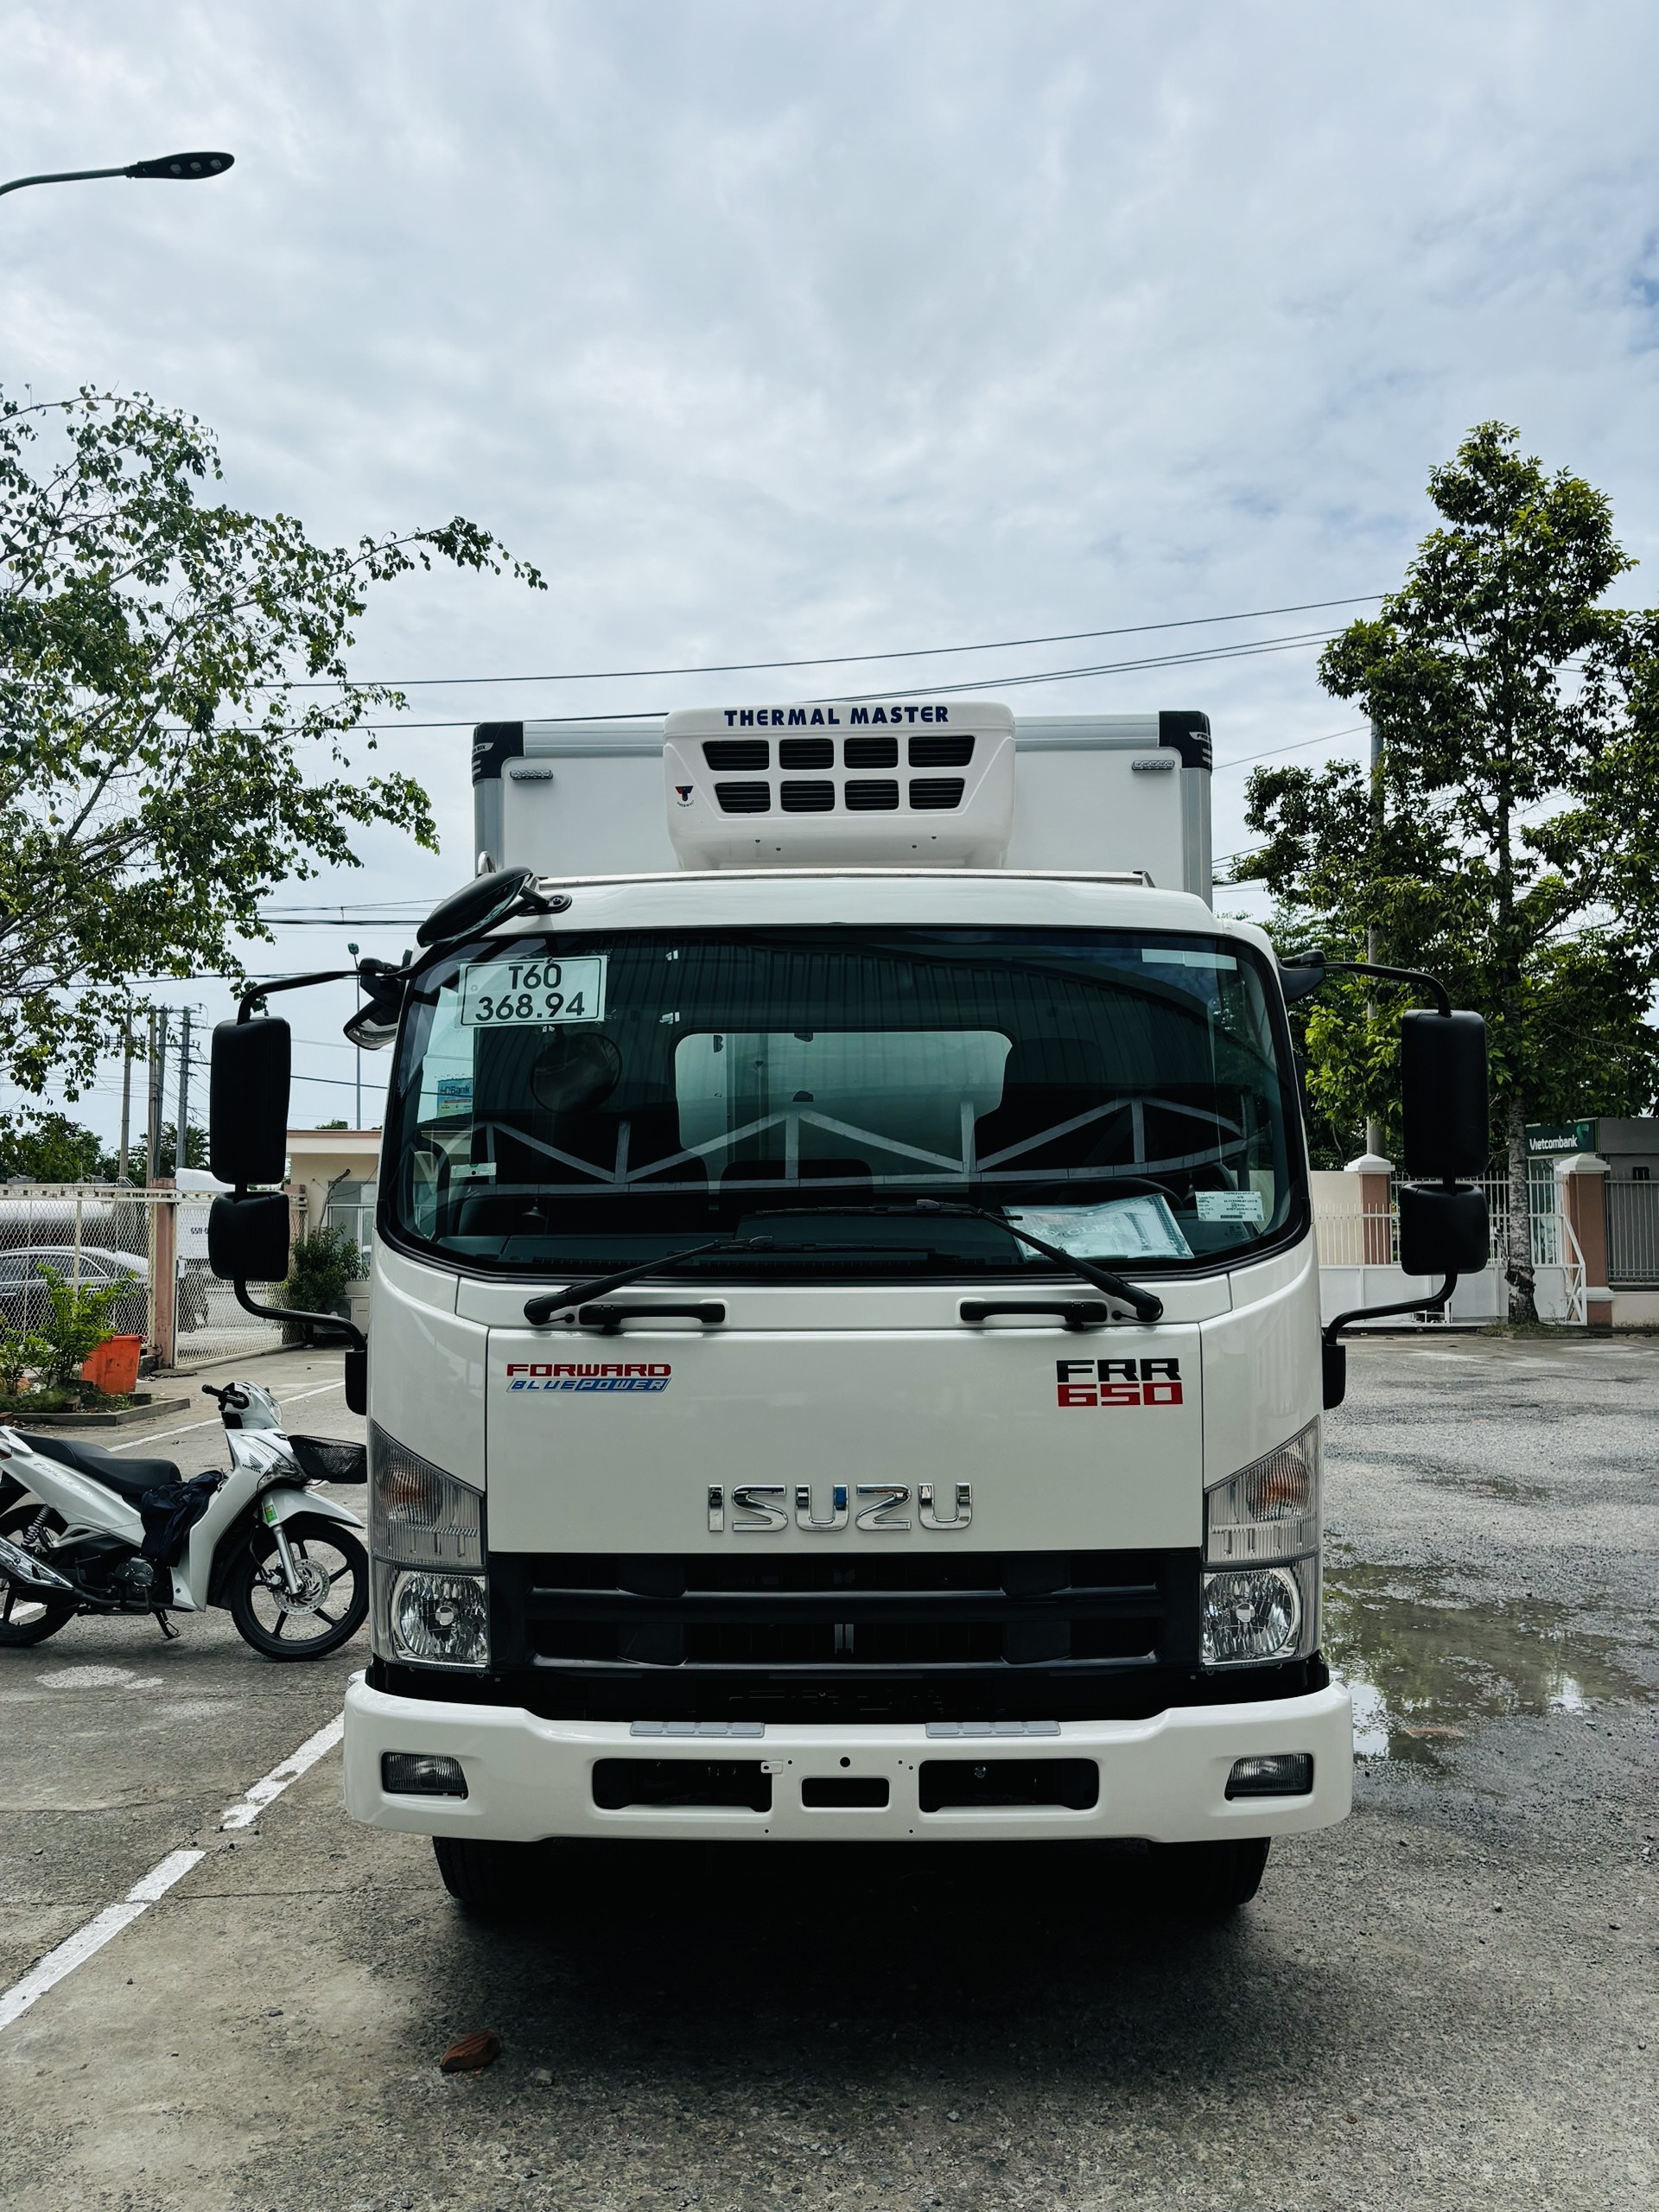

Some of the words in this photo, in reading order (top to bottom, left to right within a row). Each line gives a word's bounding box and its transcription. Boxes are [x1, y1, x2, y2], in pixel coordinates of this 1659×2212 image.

[724, 709, 841, 727] THERMAL
[850, 705, 950, 725] MASTER
[508, 963, 562, 990] T60
[475, 991, 585, 1021] 368.94
[1529, 1134, 1579, 1151] Vietcombank
[506, 1363, 671, 1377] FORWARD
[1056, 1357, 1183, 1382] FRR
[1057, 1382, 1184, 1408] 650
[242, 1463, 262, 1474] HONDA
[708, 1482, 973, 1533] ISUZU
